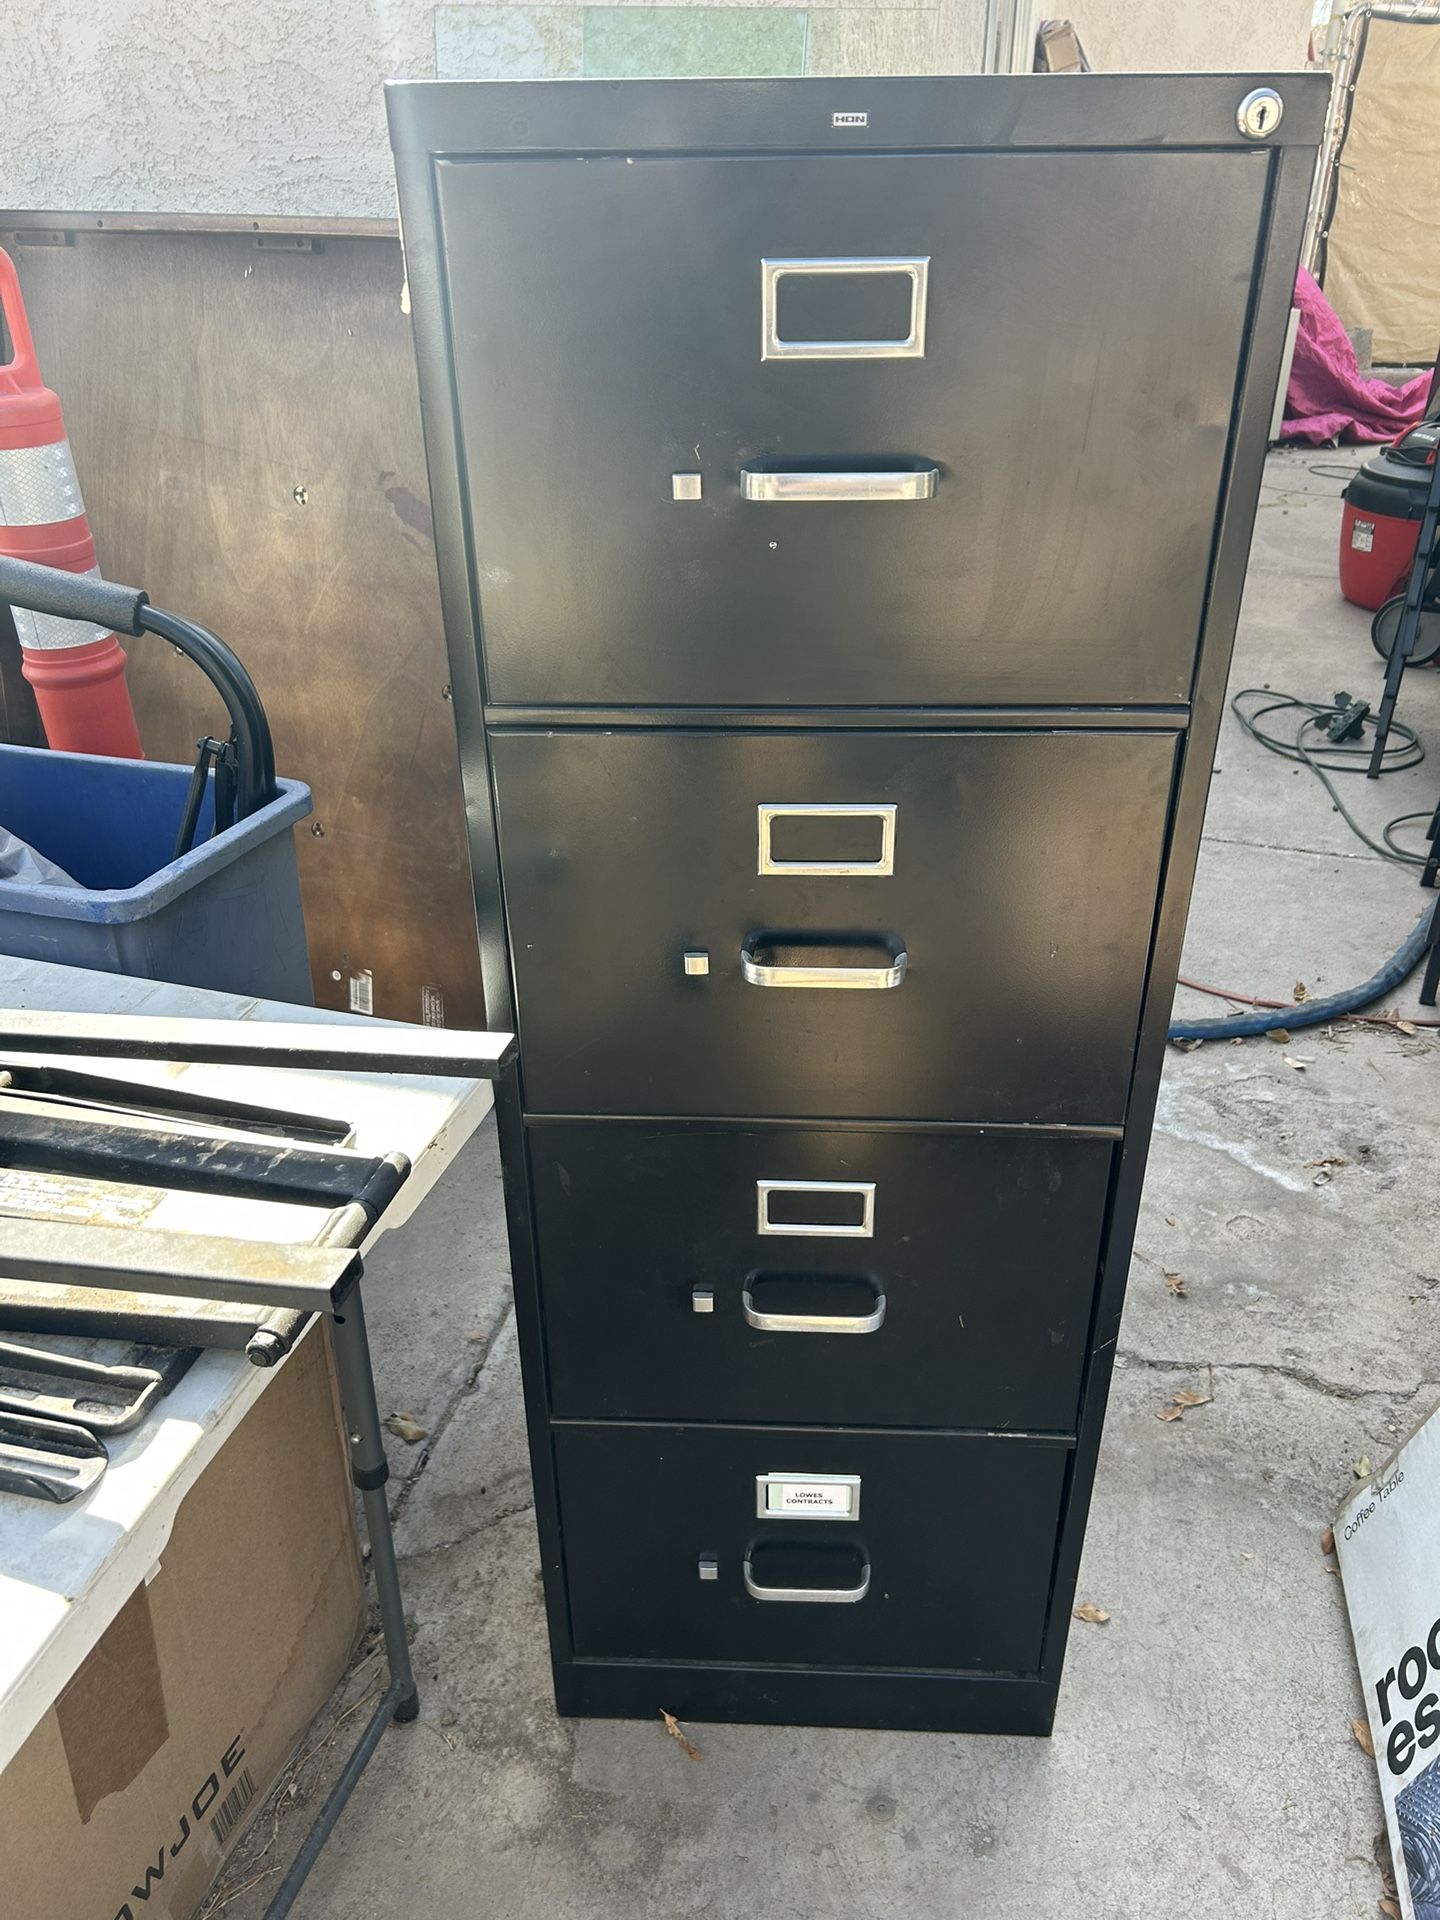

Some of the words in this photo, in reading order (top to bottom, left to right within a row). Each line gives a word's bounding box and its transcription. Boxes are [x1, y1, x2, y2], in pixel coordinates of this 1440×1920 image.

[835, 115, 865, 123] HON
[1344, 1501, 1376, 1541] Coffee
[1376, 1471, 1405, 1502] Table
